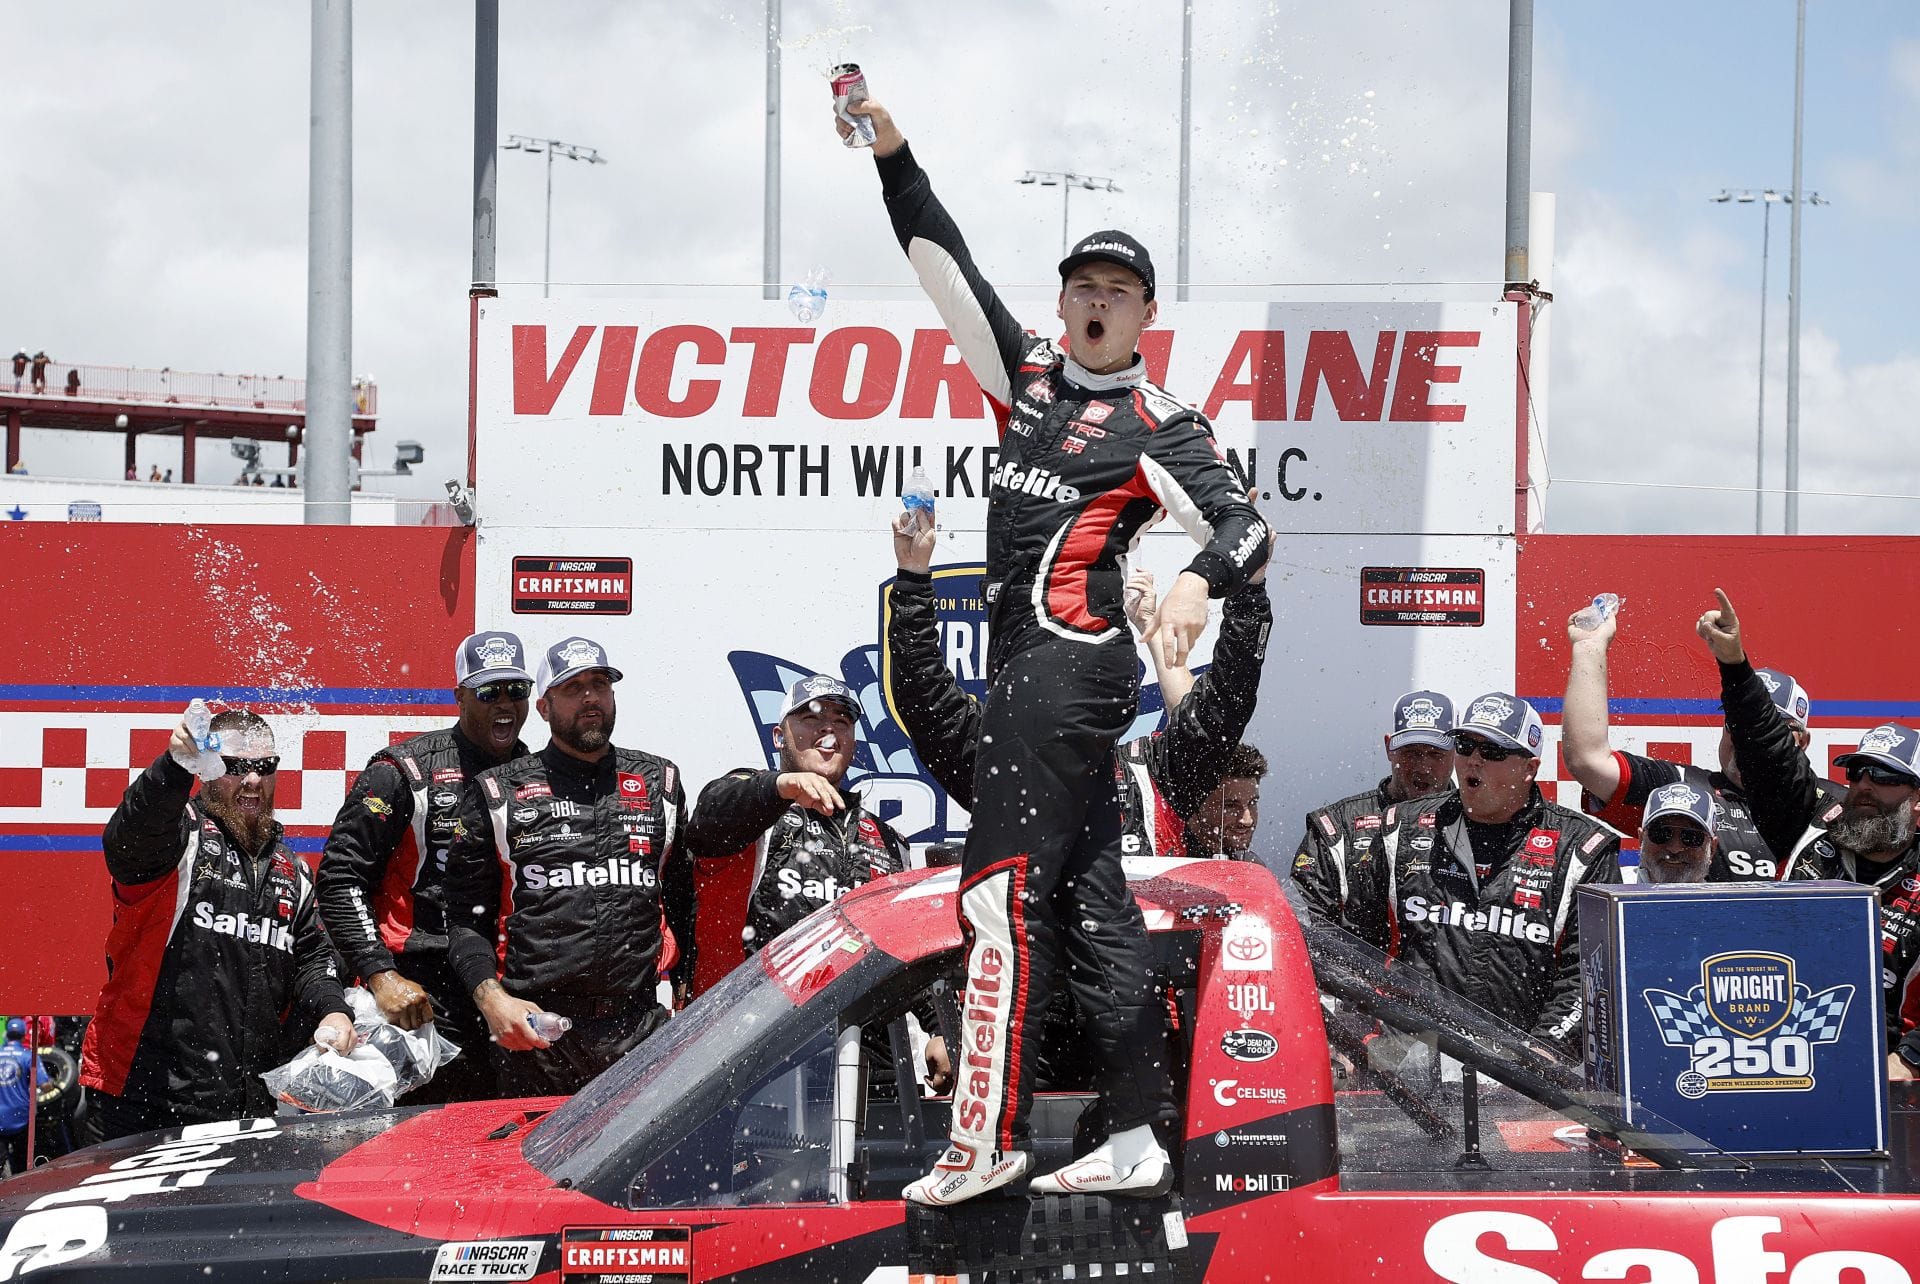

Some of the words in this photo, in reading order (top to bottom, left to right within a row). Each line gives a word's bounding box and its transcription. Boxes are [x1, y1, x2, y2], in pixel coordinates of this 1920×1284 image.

[512, 325, 1070, 420] VICTOR
[1067, 421, 1107, 439] TRD
[661, 443, 830, 498] NORTH
[993, 459, 1081, 503] afelite
[559, 562, 597, 572] NASCAR
[518, 577, 625, 594] CRAFTSMAN
[1409, 573, 1448, 583] NASCAR
[547, 601, 571, 609] TRUCK
[570, 601, 596, 609] SERIES
[932, 598, 956, 611] CON
[961, 598, 984, 611] THE
[1367, 588, 1477, 605] CRAFTSMAN
[1397, 612, 1421, 620] TRUCK
[1420, 612, 1447, 620] SERIES
[550, 801, 581, 818] JBL
[618, 813, 655, 823] GOODYEAR
[522, 859, 657, 890] Safelite
[1511, 866, 1553, 877] GOODYEAR
[1404, 896, 1550, 944] Safelite
[1227, 984, 1275, 1011] JBL
[1712, 975, 1785, 1004] WRIGHT
[1729, 1003, 1770, 1013] BRAND
[959, 947, 1004, 1133] Safelite
[1247, 1039, 1263, 1047] DEAD
[1263, 1039, 1272, 1047] ON
[1692, 1036, 1810, 1078] 250
[1237, 1087, 1286, 1099] CELSIUS
[980, 1160, 1015, 1182] Safelite
[1076, 1174, 1112, 1184] Safelite
[940, 1173, 967, 1197] sparco
[1215, 1174, 1268, 1192] Mobil
[611, 1229, 654, 1241] NASCAR
[468, 1245, 529, 1261] NASCAR
[567, 1249, 685, 1266] CRAFTSMAN
[438, 1263, 478, 1276] RACE
[482, 1262, 530, 1275] TRUCK
[598, 1274, 624, 1284] TRUCK
[624, 1274, 653, 1284] SERIES
